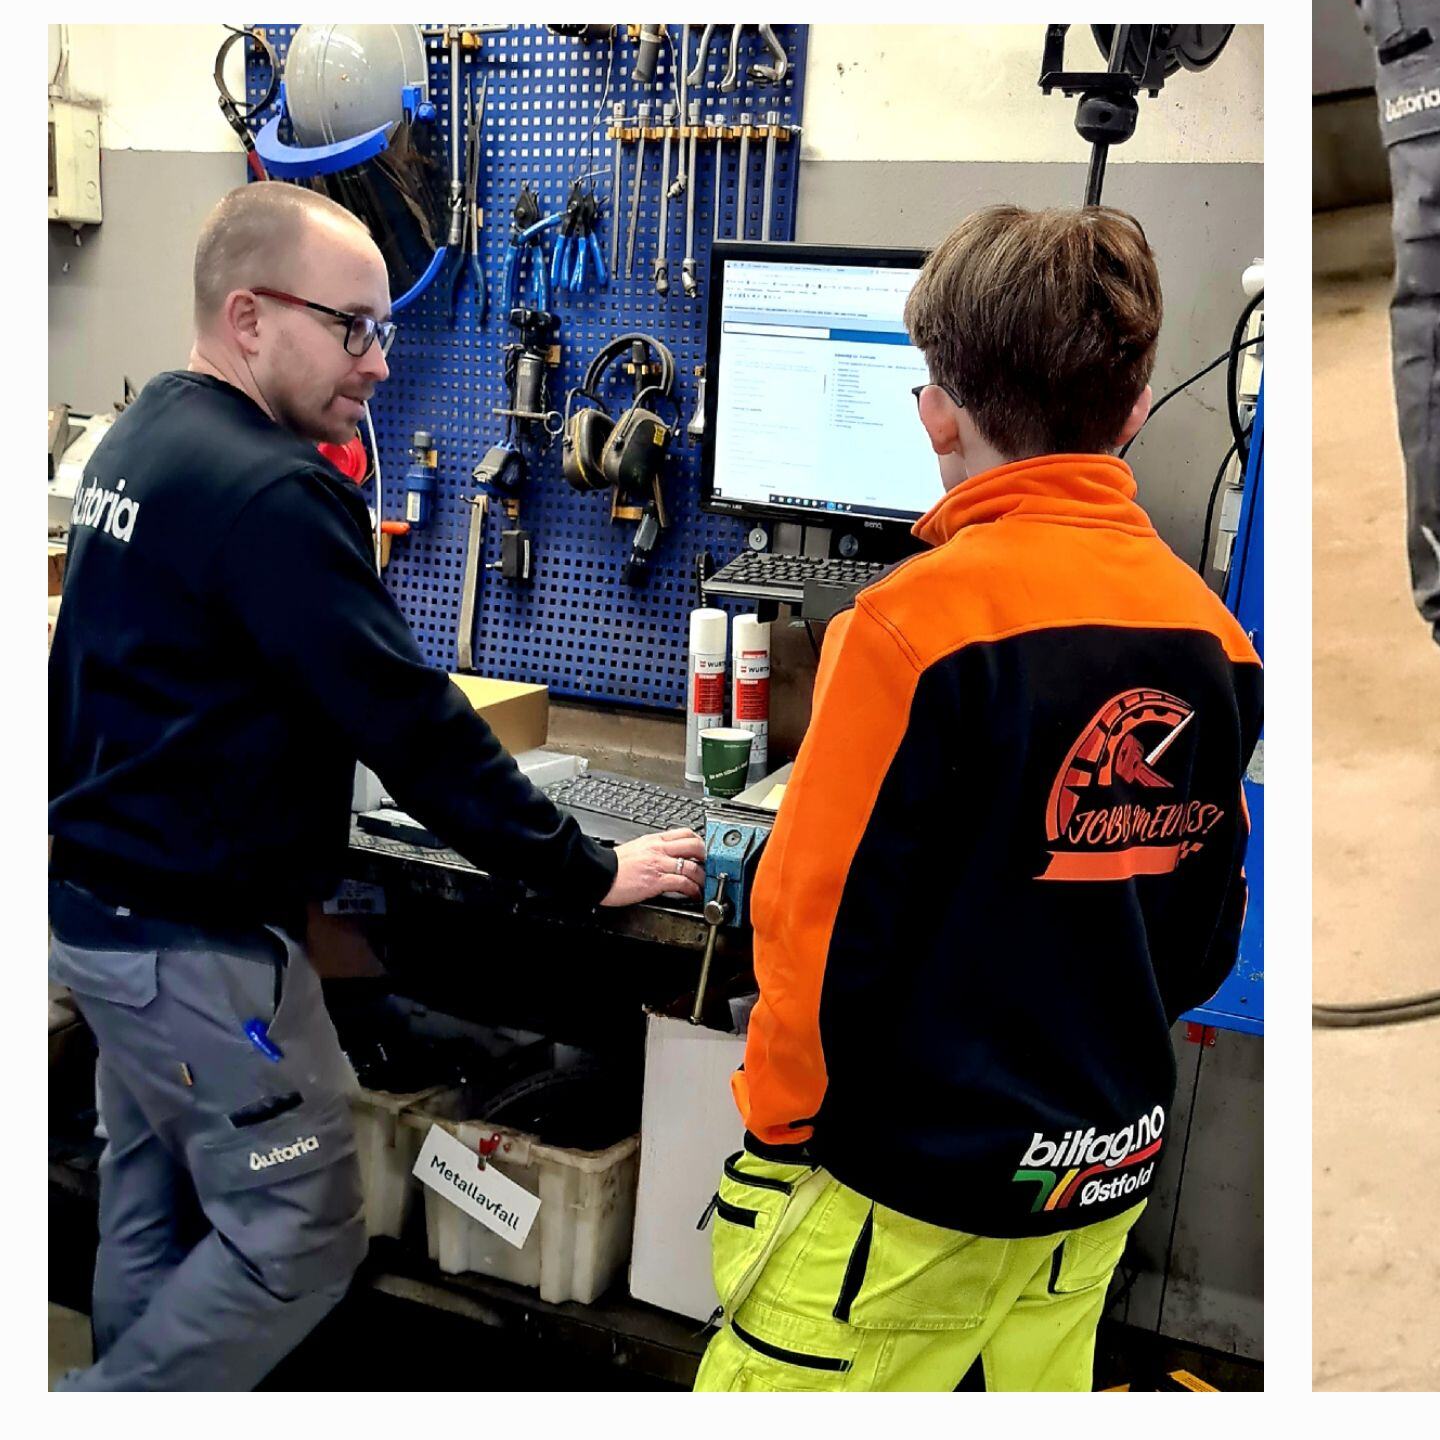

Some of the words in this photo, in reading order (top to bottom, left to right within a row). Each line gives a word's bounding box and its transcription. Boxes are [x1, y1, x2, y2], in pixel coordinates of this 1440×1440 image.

[71, 476, 140, 543] utoria
[1179, 800, 1225, 836] SS!
[249, 1135, 320, 1171] Autoria
[1019, 1105, 1165, 1167] bilfag.no
[430, 1155, 519, 1231] Metallavfall
[1079, 1162, 1154, 1207] Østfold
